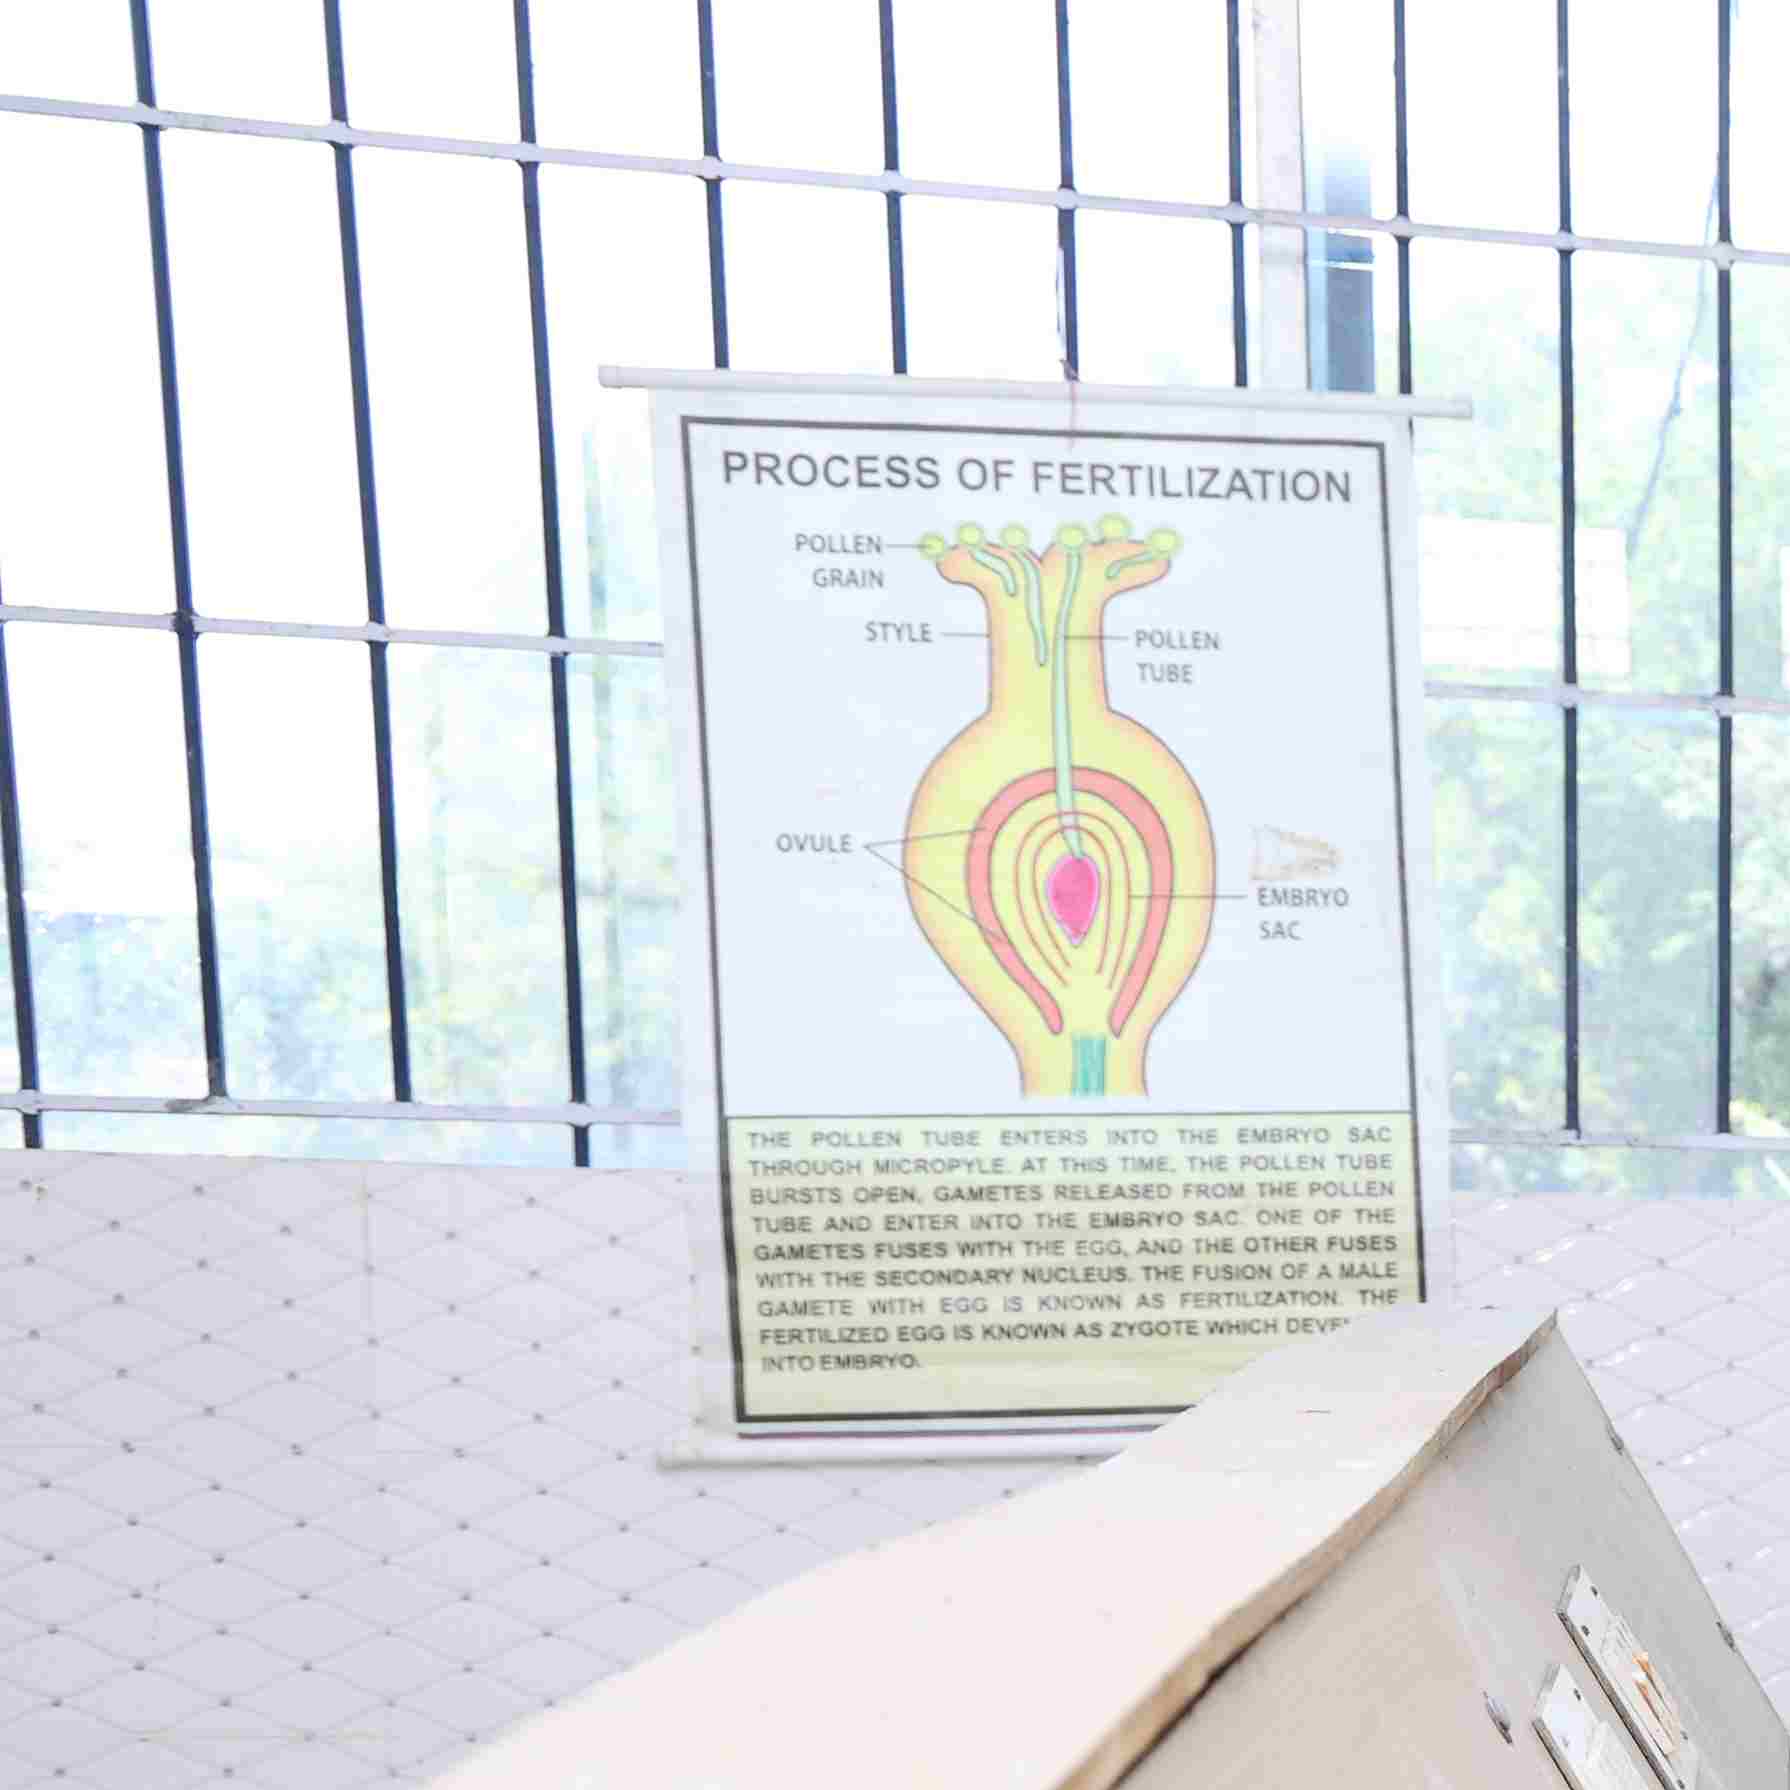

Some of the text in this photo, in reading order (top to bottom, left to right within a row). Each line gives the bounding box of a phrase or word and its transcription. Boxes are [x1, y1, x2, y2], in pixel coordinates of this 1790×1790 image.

[722, 450, 1353, 503] PROCESS OF FERTILIZATION
[794, 533, 882, 554] POLLEN
[812, 567, 884, 588] GRAIN
[864, 621, 932, 643] STYLE
[1135, 629, 1220, 650] POLLEN
[1136, 661, 1193, 683] TUBE
[775, 832, 853, 853] OVULE
[1257, 887, 1350, 907] EMBRYO
[1258, 920, 1301, 941] SAC
[748, 1127, 1392, 1149] THE POLLEN TUBE ENTERS INTO THE EMBRYO SAC
[748, 1158, 861, 1177] THROUGH
[1021, 1156, 1048, 1174] AT
[1060, 1156, 1108, 1173] THIS
[1187, 1155, 1228, 1172] THE
[1240, 1154, 1326, 1172] POLLEN
[1337, 1154, 1392, 1171] TUBE
[750, 1187, 842, 1205] BURSTS
[933, 1185, 1043, 1203] GAMETES
[1054, 1183, 1172, 1202] RELEASED
[1183, 1183, 1245, 1200] FROM
[1258, 1182, 1297, 1199] THE
[1309, 1181, 1394, 1199] POLLEN
[752, 1216, 813, 1233] TUBE
[824, 1215, 872, 1232] AND
[884, 1214, 959, 1232] ENTER
[969, 1213, 1023, 1230] INTO
[1035, 1212, 1078, 1230] THE
[1089, 1210, 1184, 1229] EMBRYO
[1256, 1209, 1303, 1226] ONE
[1313, 1208, 1342, 1226] OF
[1354, 1207, 1396, 1225] THE
[754, 1243, 865, 1261] GAMETES
[874, 1242, 948, 1260] FUSES
[956, 1241, 1013, 1258] WITH
[1023, 1240, 1065, 1257] THE
[1136, 1238, 1183, 1256] AND
[1193, 1237, 1234, 1255] THE
[1243, 1236, 1318, 1254] OTHER
[1327, 1235, 1398, 1253] FUSES
[755, 1271, 814, 1289] WITH
[821, 1270, 865, 1288] THE
[875, 1268, 1013, 1287] SECONDARY
[1143, 1265, 1184, 1283] THE
[1192, 1264, 1272, 1282] FUSION
[1280, 1263, 1310, 1281] OF
[1316, 1263, 1333, 1280] A
[1339, 1262, 1398, 1280] MALE
[757, 1298, 854, 1317] GAMETE
[867, 1297, 924, 1315] WITH
[940, 1296, 989, 1314] EGG
[1003, 1295, 1023, 1312] IS
[1038, 1293, 1122, 1312] KNOWN
[1136, 1293, 1165, 1310] AS
[1358, 1288, 1398, 1305] THE
[759, 1326, 889, 1345] FERTILIZED
[896, 1325, 945, 1342] EGG
[954, 1324, 973, 1341] IS
[982, 1322, 1065, 1340] KNOWN
[1072, 1321, 1102, 1338] AS
[1110, 1319, 1199, 1338] ZYGOTE
[1205, 1318, 1277, 1336] WHICH
[761, 1355, 815, 1373] INTO
